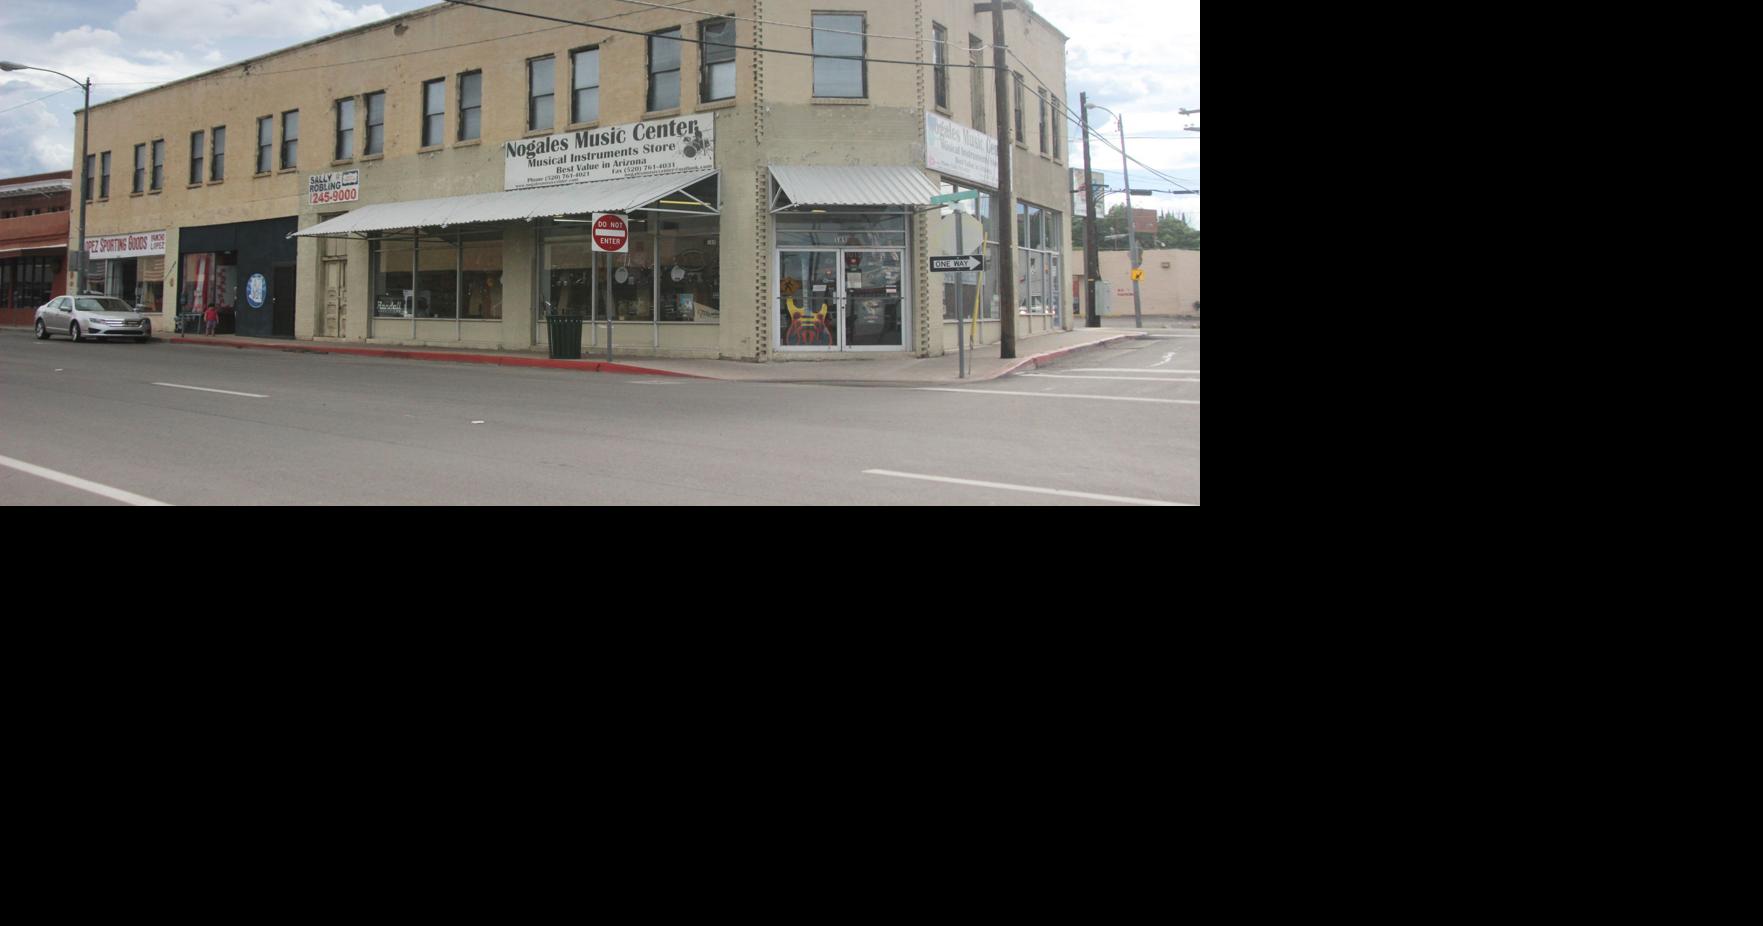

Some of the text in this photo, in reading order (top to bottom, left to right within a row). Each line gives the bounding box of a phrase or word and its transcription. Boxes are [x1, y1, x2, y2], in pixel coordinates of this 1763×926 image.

[507, 119, 698, 159] Nogales Music Center
[528, 143, 676, 168] Musical Instruments Store
[556, 165, 574, 174] Best
[577, 163, 599, 171] Value
[613, 158, 647, 167] Arizona
[310, 174, 332, 185] SALLY
[310, 182, 341, 192] ROBLING
[312, 188, 357, 203] 245-9000
[86, 235, 148, 253] OPEZ SPORTING GOODS
[600, 237, 621, 245] ENTER
[935, 260, 951, 268] ONE
